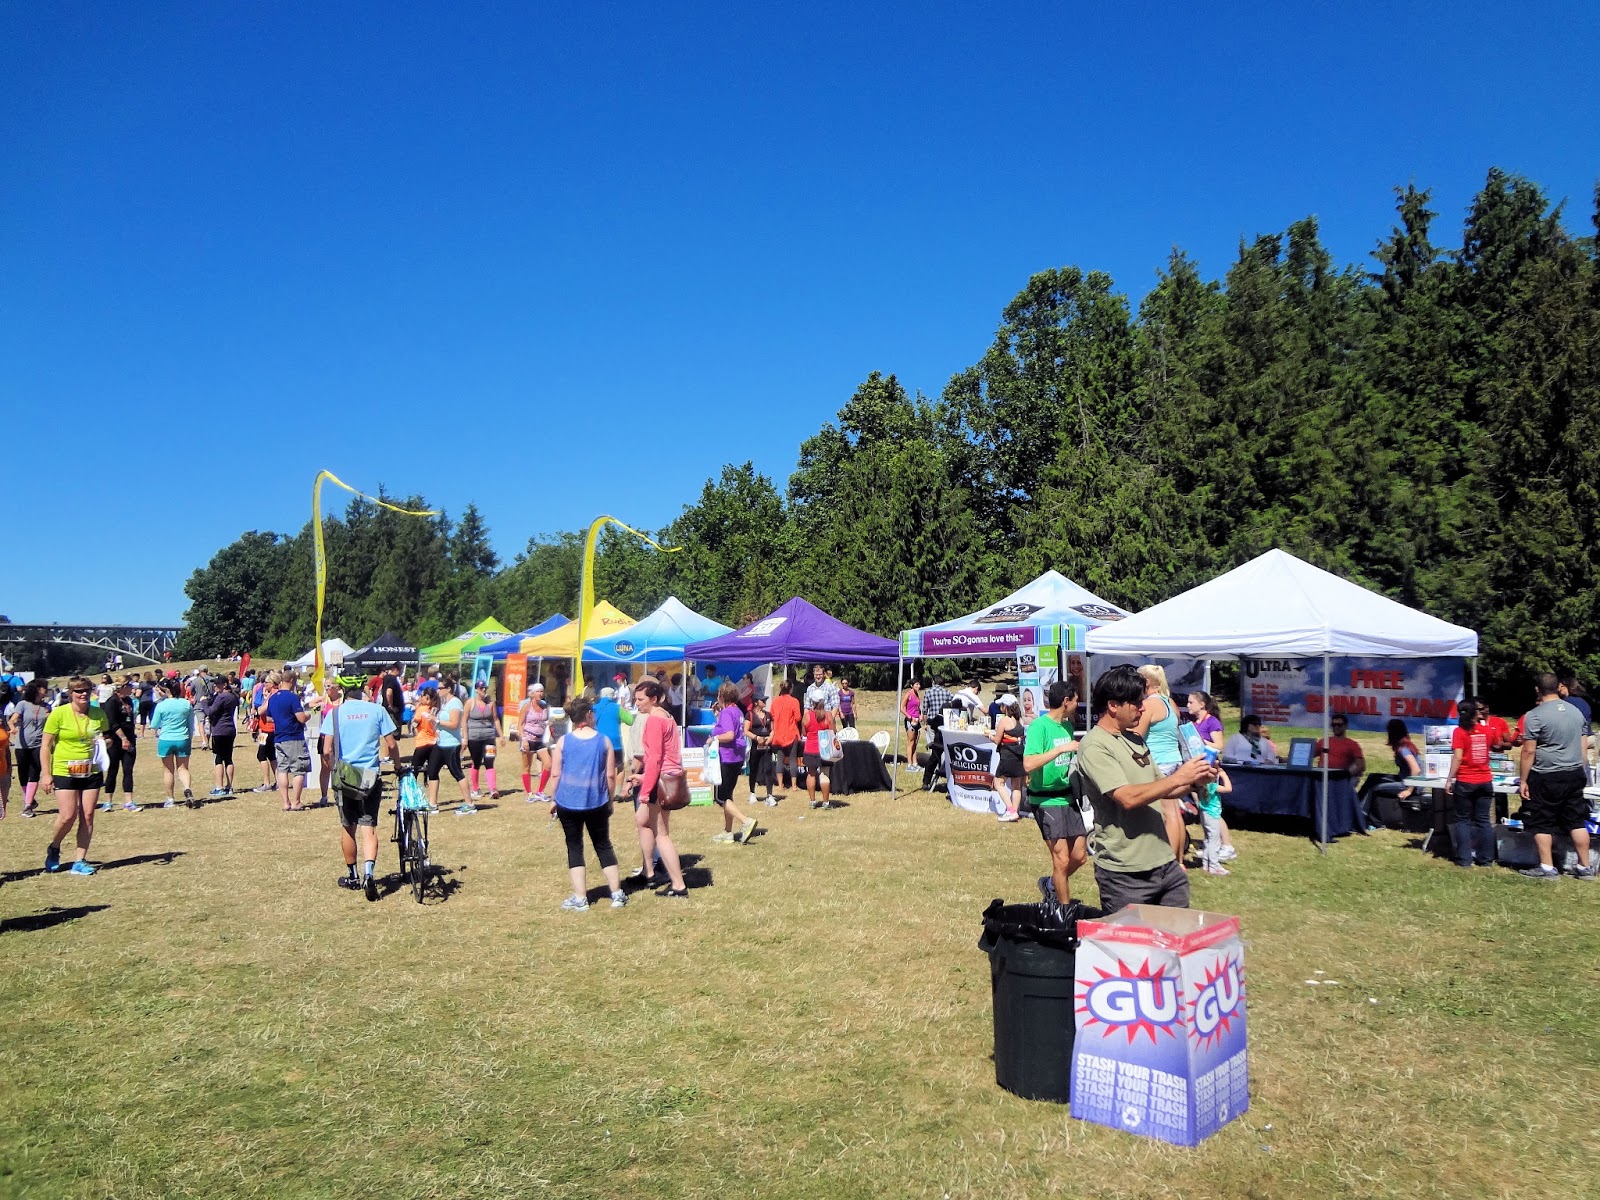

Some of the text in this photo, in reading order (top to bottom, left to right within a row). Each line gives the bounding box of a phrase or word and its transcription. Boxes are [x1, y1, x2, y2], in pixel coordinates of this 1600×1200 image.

[932, 637, 951, 646] You're
[952, 635, 967, 645] SO
[967, 637, 988, 645] gonna
[989, 634, 1005, 643] love
[1246, 660, 1292, 678] ULTRA
[1352, 669, 1405, 690] FREE
[1390, 697, 1459, 719] EXAM
[953, 746, 978, 762] SO
[968, 774, 986, 782] FREE
[1089, 979, 1178, 1023] GU
[1196, 963, 1240, 1034] GU
[1078, 1053, 1187, 1092] STASH YOUR TRASH
[1195, 1069, 1215, 1092] STASH
[1077, 1065, 1187, 1105] STASH YOUR TRASH
[1076, 1079, 1187, 1118] STASH YOUR TRASH
[1075, 1091, 1113, 1112] STASH
[1149, 1109, 1187, 1132] TRASH
